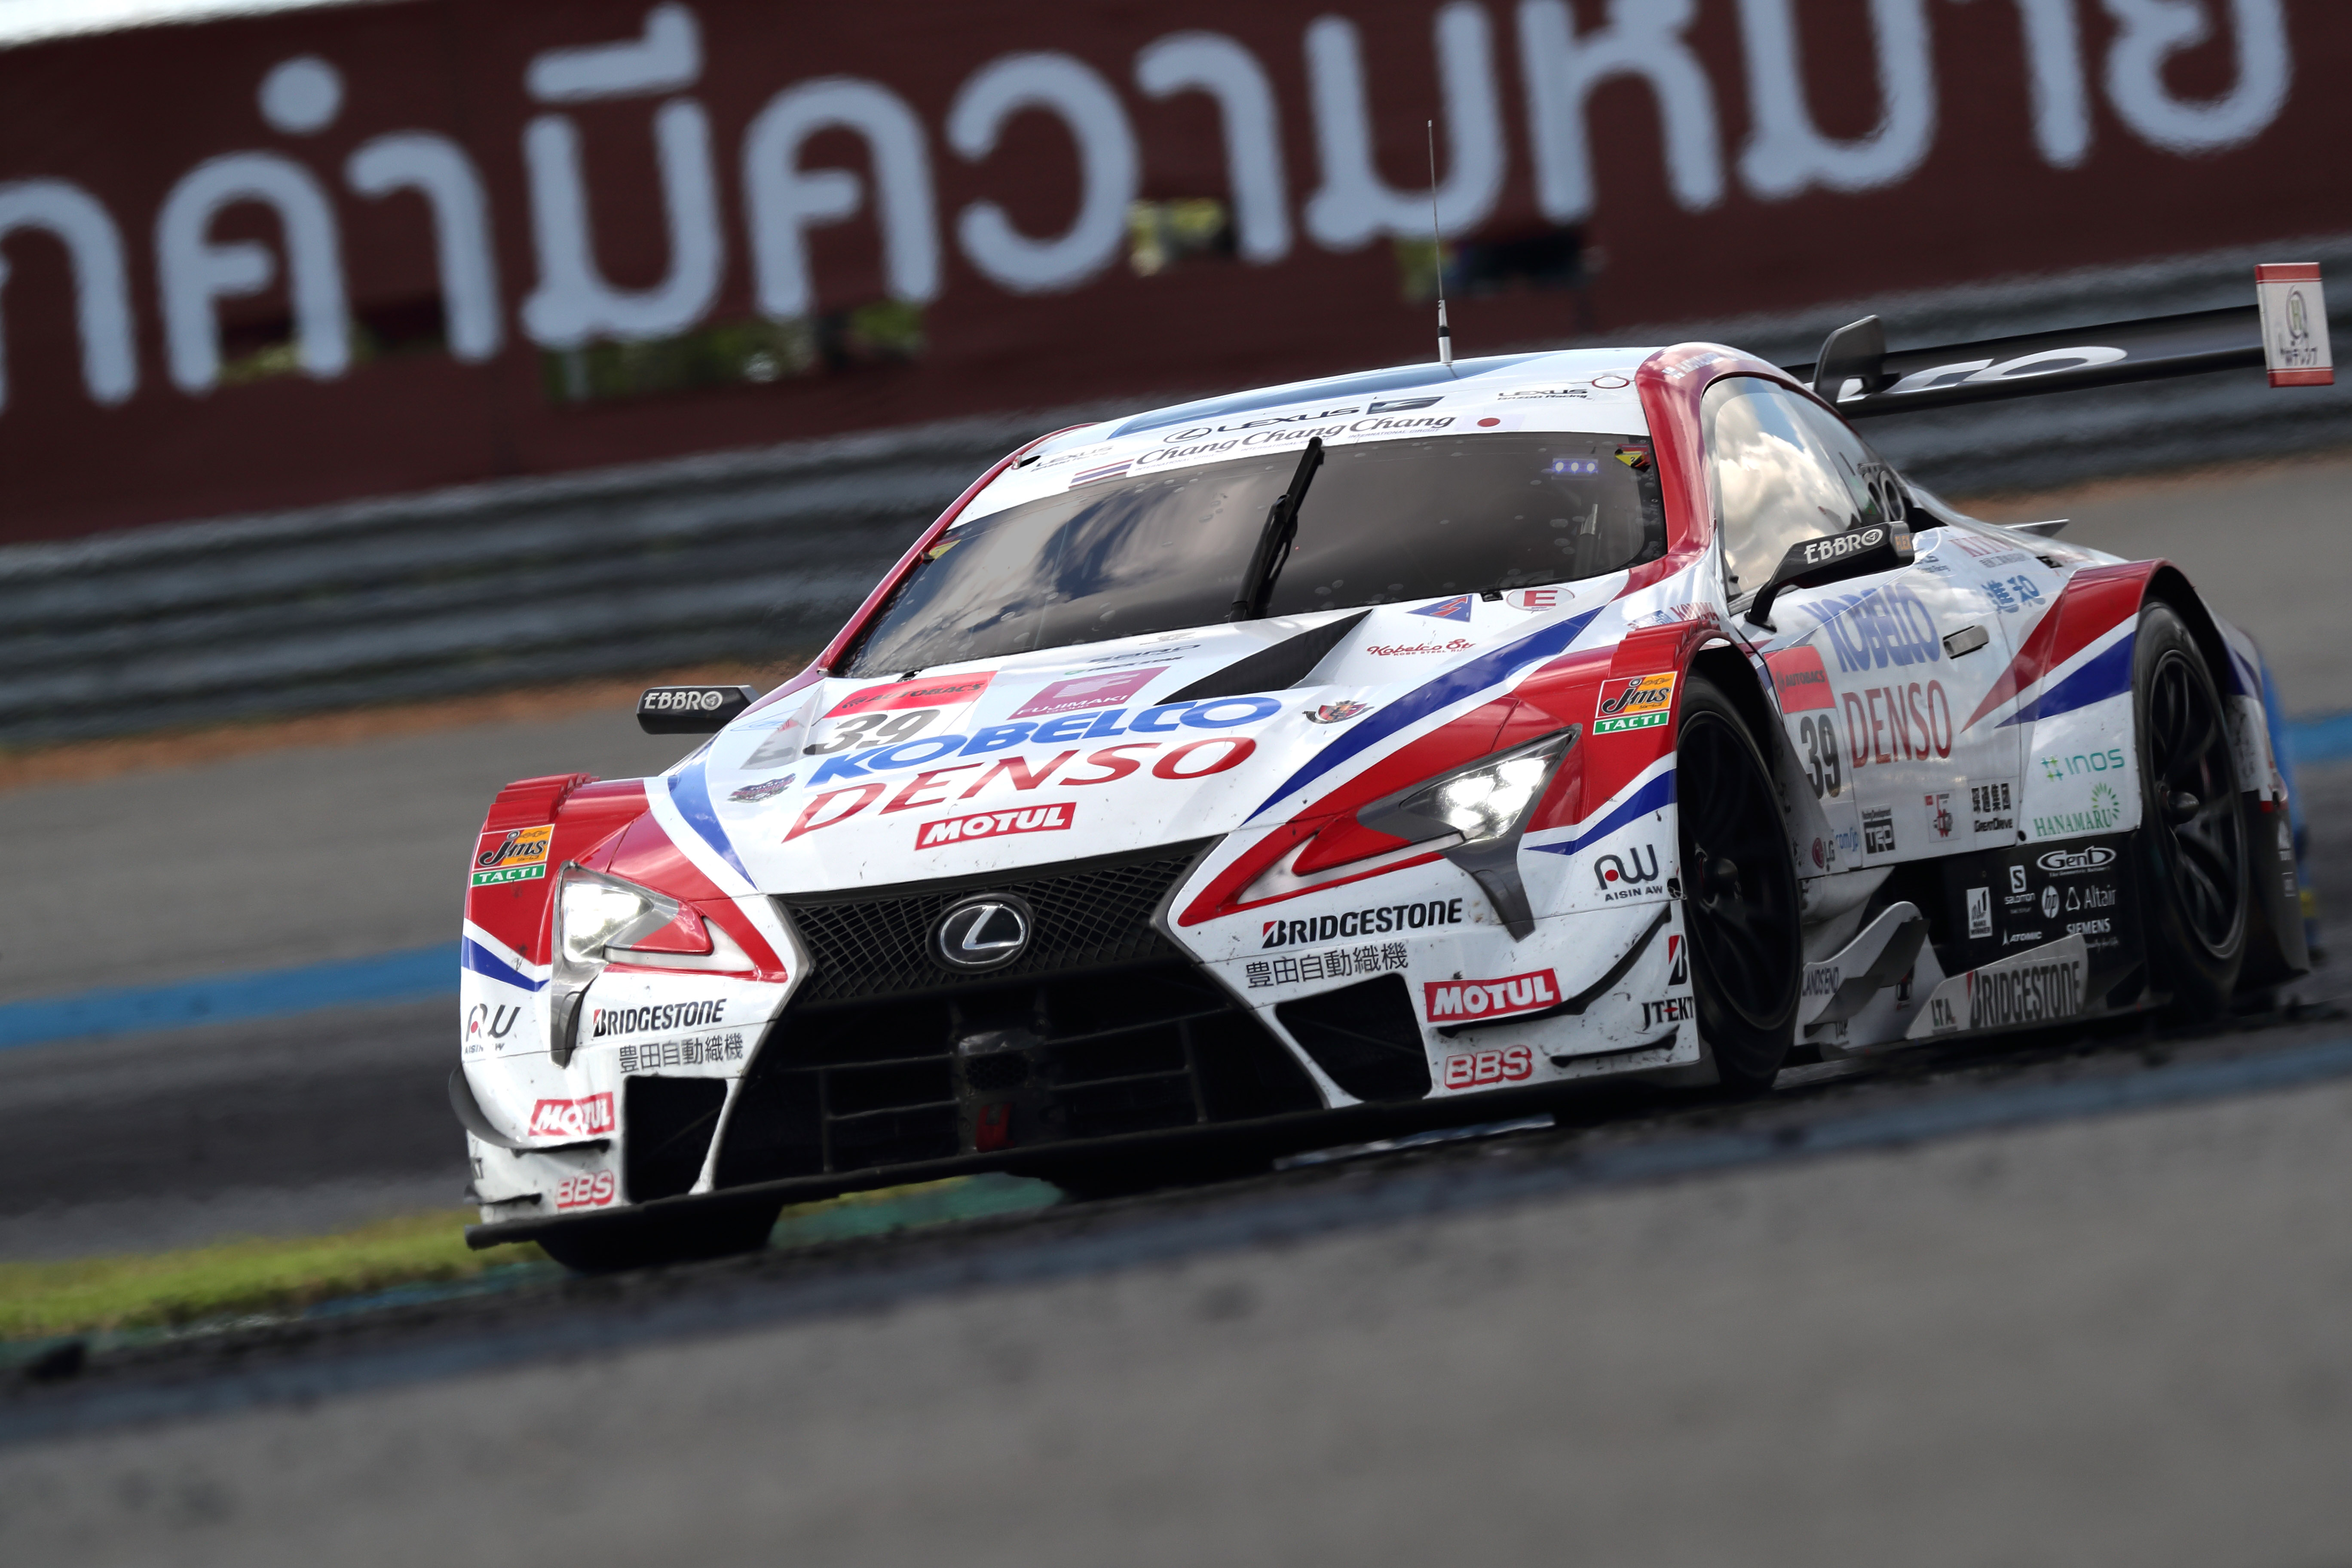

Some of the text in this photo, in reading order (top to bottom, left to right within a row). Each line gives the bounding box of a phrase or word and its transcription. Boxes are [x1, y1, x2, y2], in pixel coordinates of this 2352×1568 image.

[1217, 406, 1361, 432] LEXUS
[1136, 439, 1240, 465] Chang
[1242, 425, 1348, 445] Chang
[1349, 416, 1457, 432] Chang
[1804, 528, 1883, 565] EBBRO
[1523, 590, 1558, 607] E
[1366, 643, 1443, 656] Kobelco
[867, 683, 986, 703] AUTOBACS
[1785, 670, 1825, 687] AUTOBACS
[644, 690, 723, 710] EBBRO
[1017, 695, 1128, 715] FUJIMAKI
[803, 709, 940, 755] 39
[1602, 714, 1660, 731] TACTI
[1841, 679, 1953, 768] DENSO
[805, 697, 1282, 788] KOBELCO
[1800, 714, 1841, 799] 39
[781, 737, 1256, 844] DENSO
[921, 806, 1066, 845] MOTUL
[2033, 808, 2113, 837] HANAMARU
[479, 867, 537, 882] TACTI
[1605, 885, 1663, 902] AISIN AW
[2084, 884, 2117, 909] Altair
[1262, 898, 1463, 949] BRIDGESTONE
[2009, 931, 2043, 942] ATOMIC
[2066, 918, 2111, 935] SIEMENS
[1245, 942, 1409, 989] 豊田自動織機
[1433, 975, 1554, 1016] MOTUL
[1967, 960, 2080, 1029] BRIDGESTONE
[592, 998, 728, 1038] BRIDGESTONE
[1641, 995, 1694, 1032] JTEKT
[619, 1032, 744, 1074] 豊田自動織機
[1444, 1044, 1533, 1090] BBS
[554, 1169, 614, 1208] BBS
